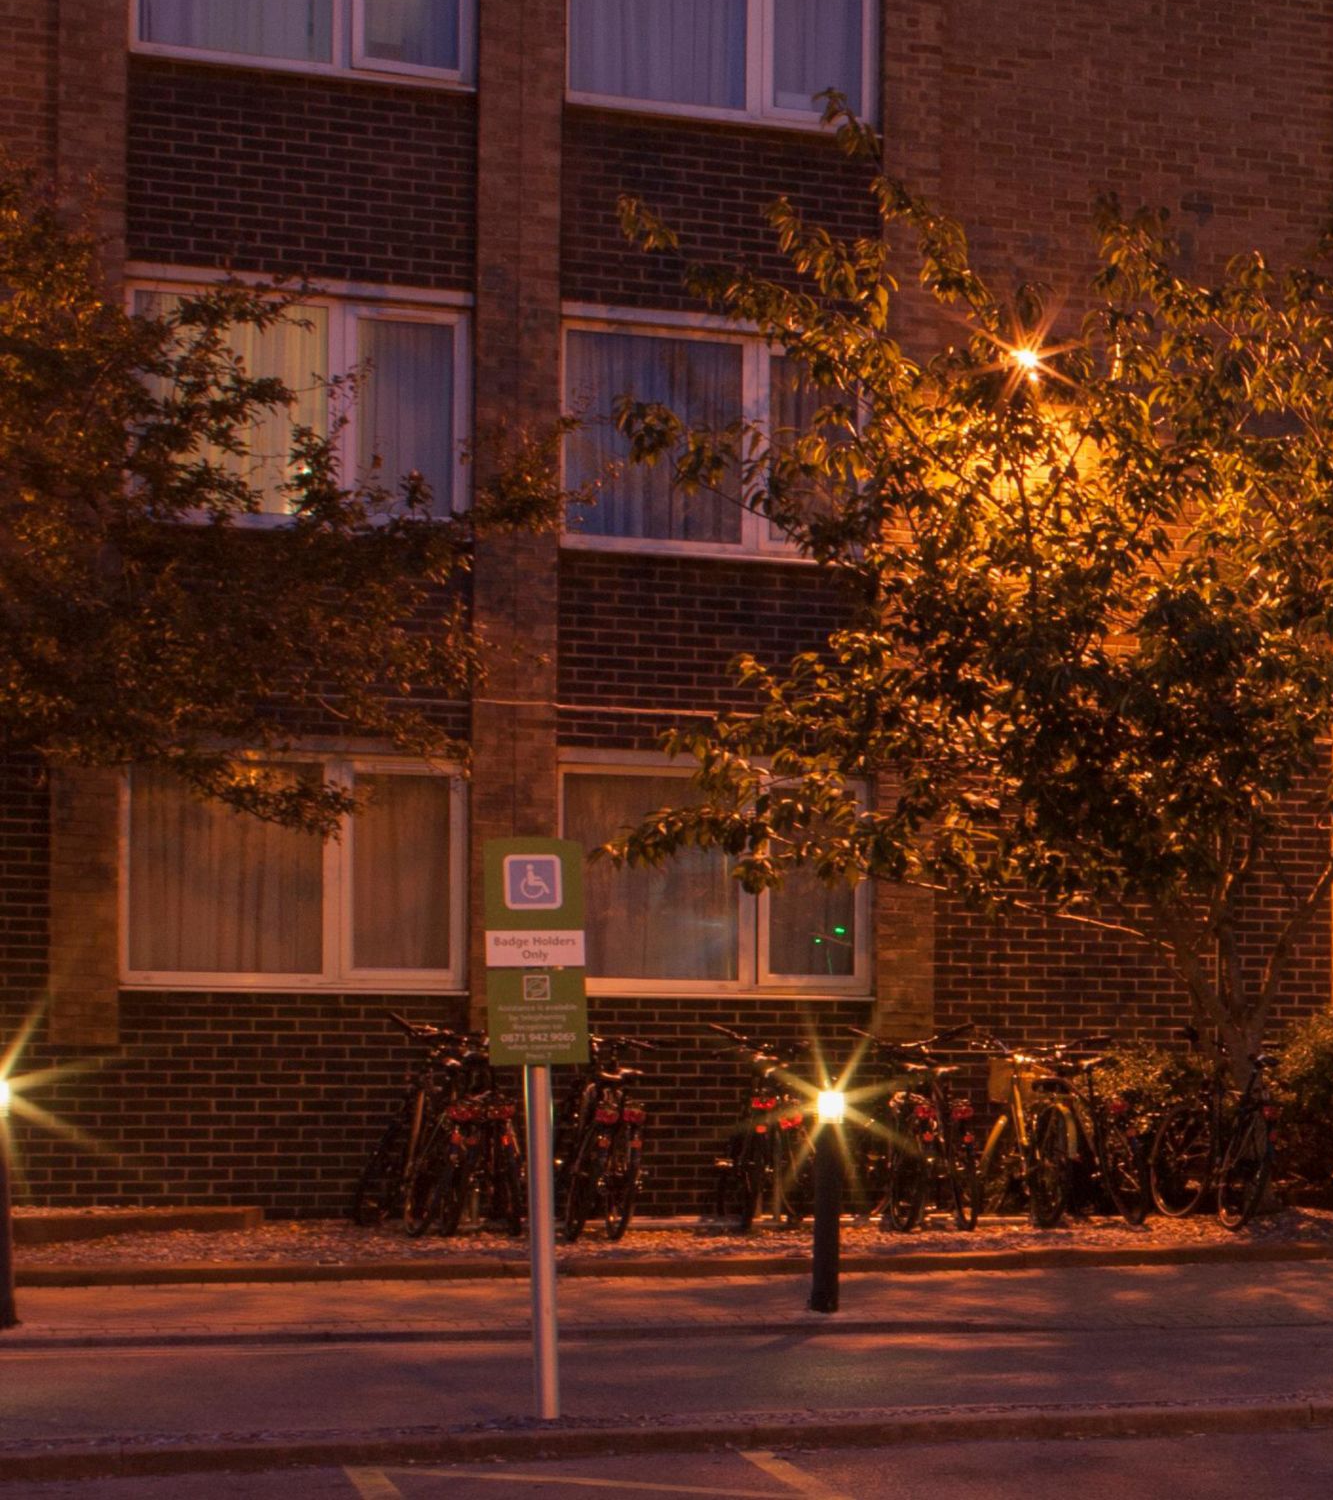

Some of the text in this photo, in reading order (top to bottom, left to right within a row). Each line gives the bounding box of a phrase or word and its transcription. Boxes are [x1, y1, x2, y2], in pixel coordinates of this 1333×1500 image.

[494, 936, 576, 948] Badge Holders
[522, 950, 548, 961] Only
[500, 1033, 526, 1042] 0871
[528, 1033, 548, 1042] 942
